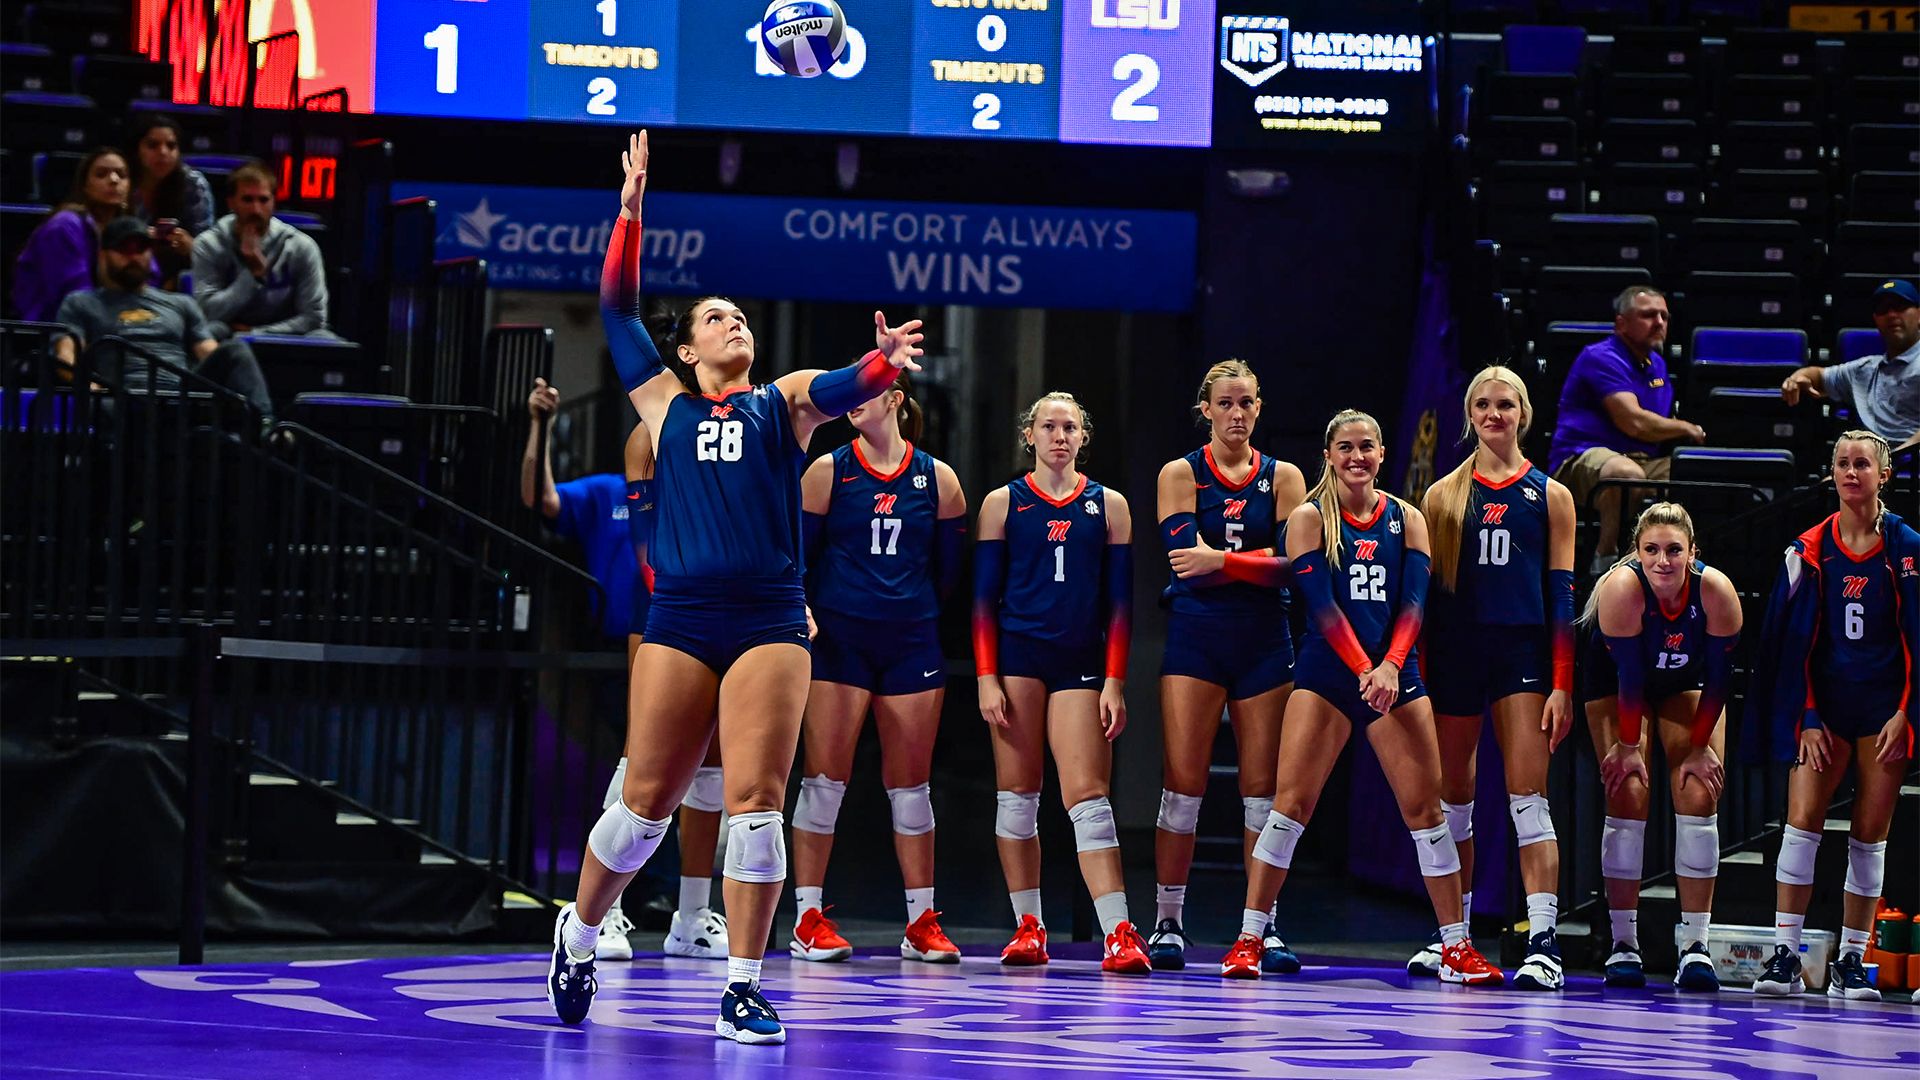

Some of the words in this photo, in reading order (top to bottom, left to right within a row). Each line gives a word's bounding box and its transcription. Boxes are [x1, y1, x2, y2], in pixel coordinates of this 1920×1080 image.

[596, 0, 616, 36] 1
[775, 19, 823, 39] molten
[976, 15, 1007, 52] 0
[424, 24, 459, 94] 1
[543, 43, 658, 70] TIMEOUTS
[1232, 32, 1277, 63] NTS
[931, 60, 1044, 84] TIMEOUTS
[1111, 54, 1160, 122] 2
[587, 77, 617, 116] 2
[972, 93, 1001, 130] 2
[500, 218, 704, 268] accutmp
[784, 208, 967, 243] COMFORT
[982, 216, 1133, 250] ALWAYS
[888, 250, 1023, 294] WINS
[697, 420, 743, 461] 28
[870, 517, 902, 555] 17
[1224, 522, 1244, 554] 5
[1478, 528, 1511, 566] 10
[1054, 545, 1065, 582] 1
[1349, 563, 1386, 602] 22
[1845, 602, 1864, 640] 6
